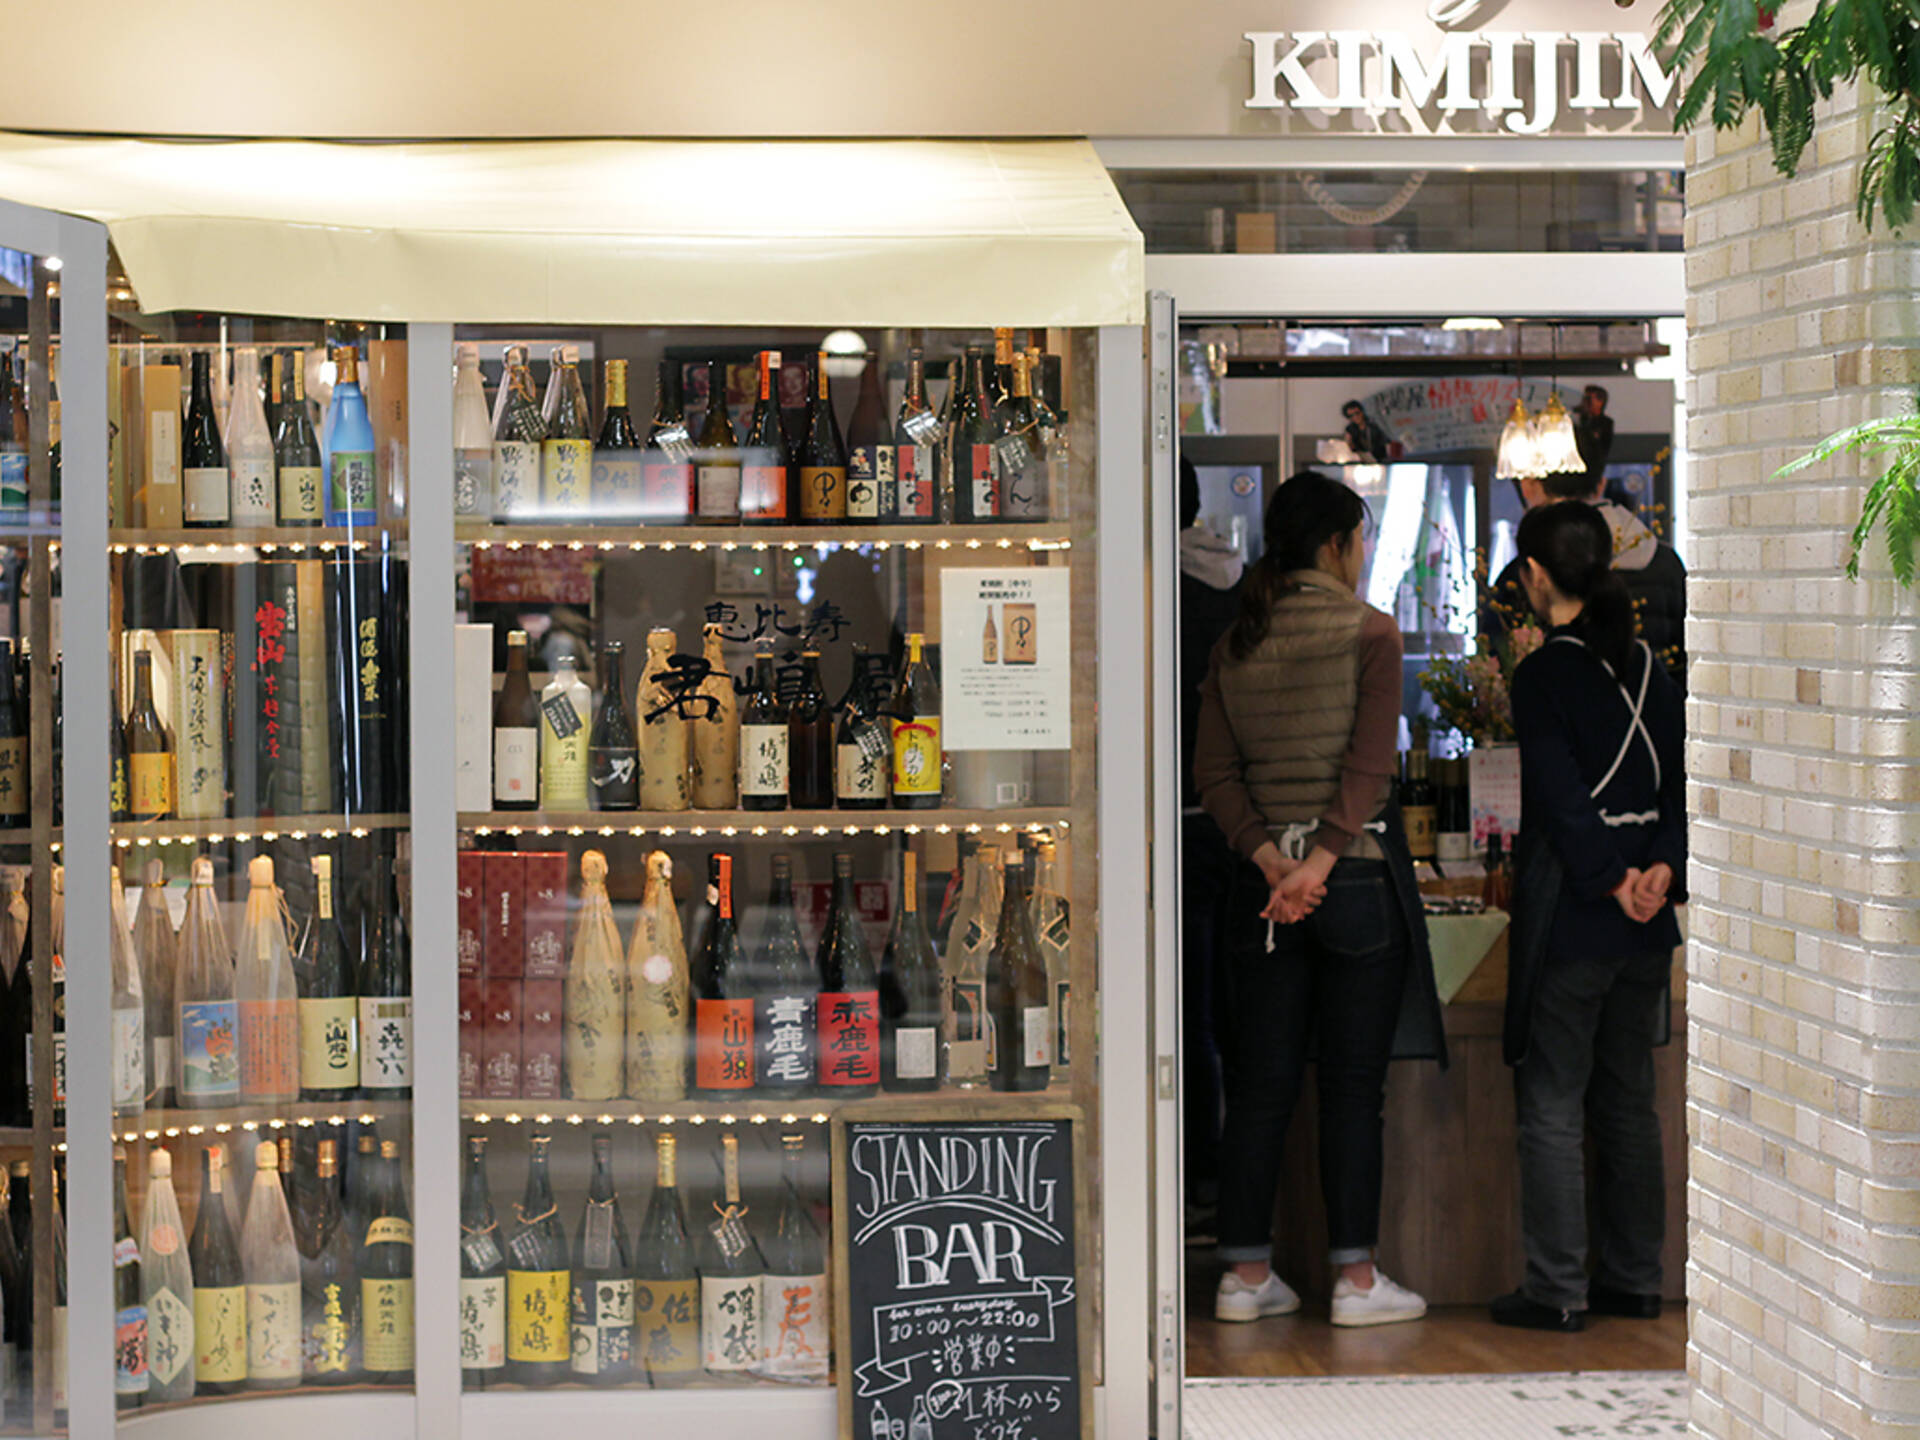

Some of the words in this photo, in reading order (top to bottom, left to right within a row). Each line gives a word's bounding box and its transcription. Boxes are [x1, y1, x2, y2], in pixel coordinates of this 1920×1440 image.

[704, 600, 851, 643] 恵比寿
[325, 1025, 349, 1069] 山ねこ
[722, 1019, 749, 1080] 山猿
[764, 995, 810, 1081] 青鹿毛
[830, 999, 874, 1079] 赤鹿毛
[852, 1134, 1057, 1223] STANDING
[891, 1220, 1032, 1290] BAR
